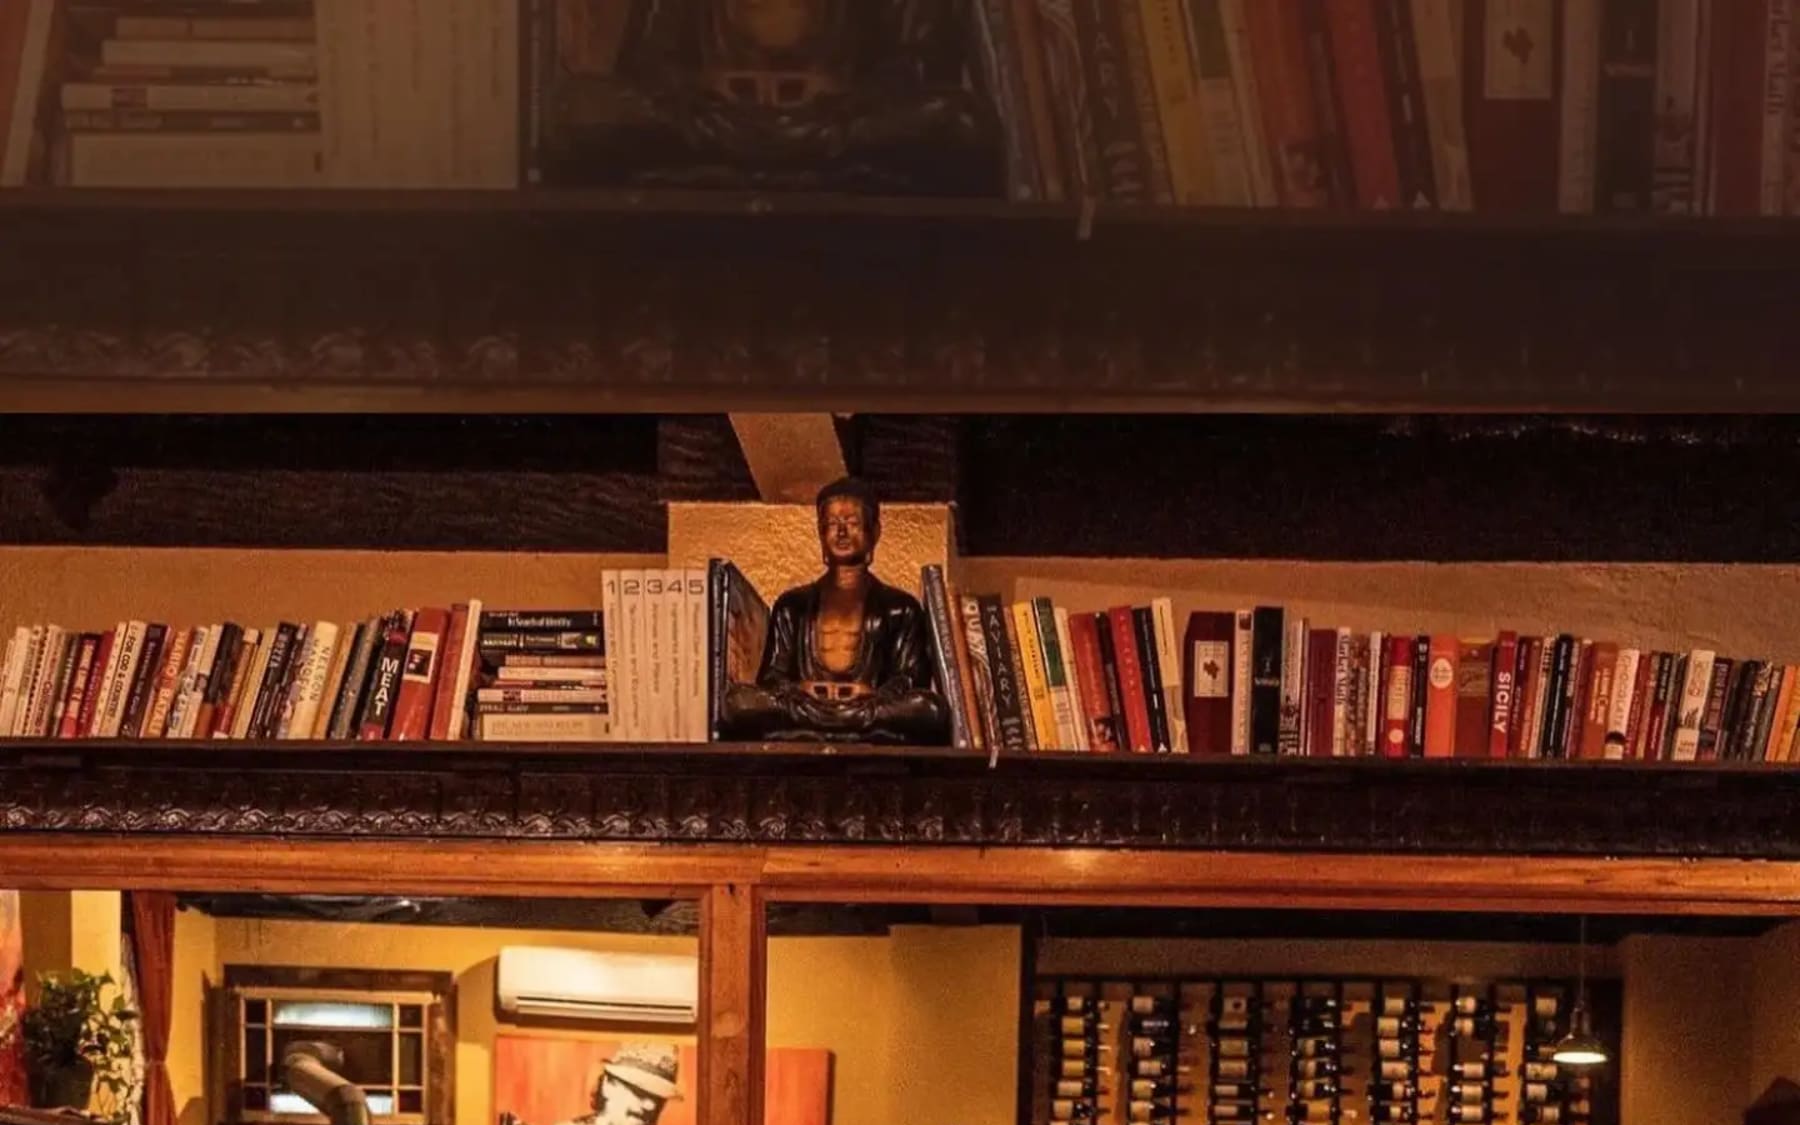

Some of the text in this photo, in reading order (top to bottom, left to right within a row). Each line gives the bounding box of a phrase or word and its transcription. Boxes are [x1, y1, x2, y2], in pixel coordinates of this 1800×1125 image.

[606, 580, 614, 596] 1
[624, 580, 640, 596] 2
[647, 580, 663, 596] 3
[666, 580, 682, 596] 4
[689, 580, 704, 596] 5
[119, 653, 131, 671] COD
[124, 635, 135, 653] FOR
[990, 615, 1012, 710] AVIARY
[149, 631, 187, 735] MARIO BATALI
[297, 638, 320, 702] MANDELA
[309, 645, 331, 702] NELSON
[374, 657, 400, 716] MEAT
[1493, 671, 1512, 733] SICILY
[1613, 655, 1632, 727] CHOCOLATE
